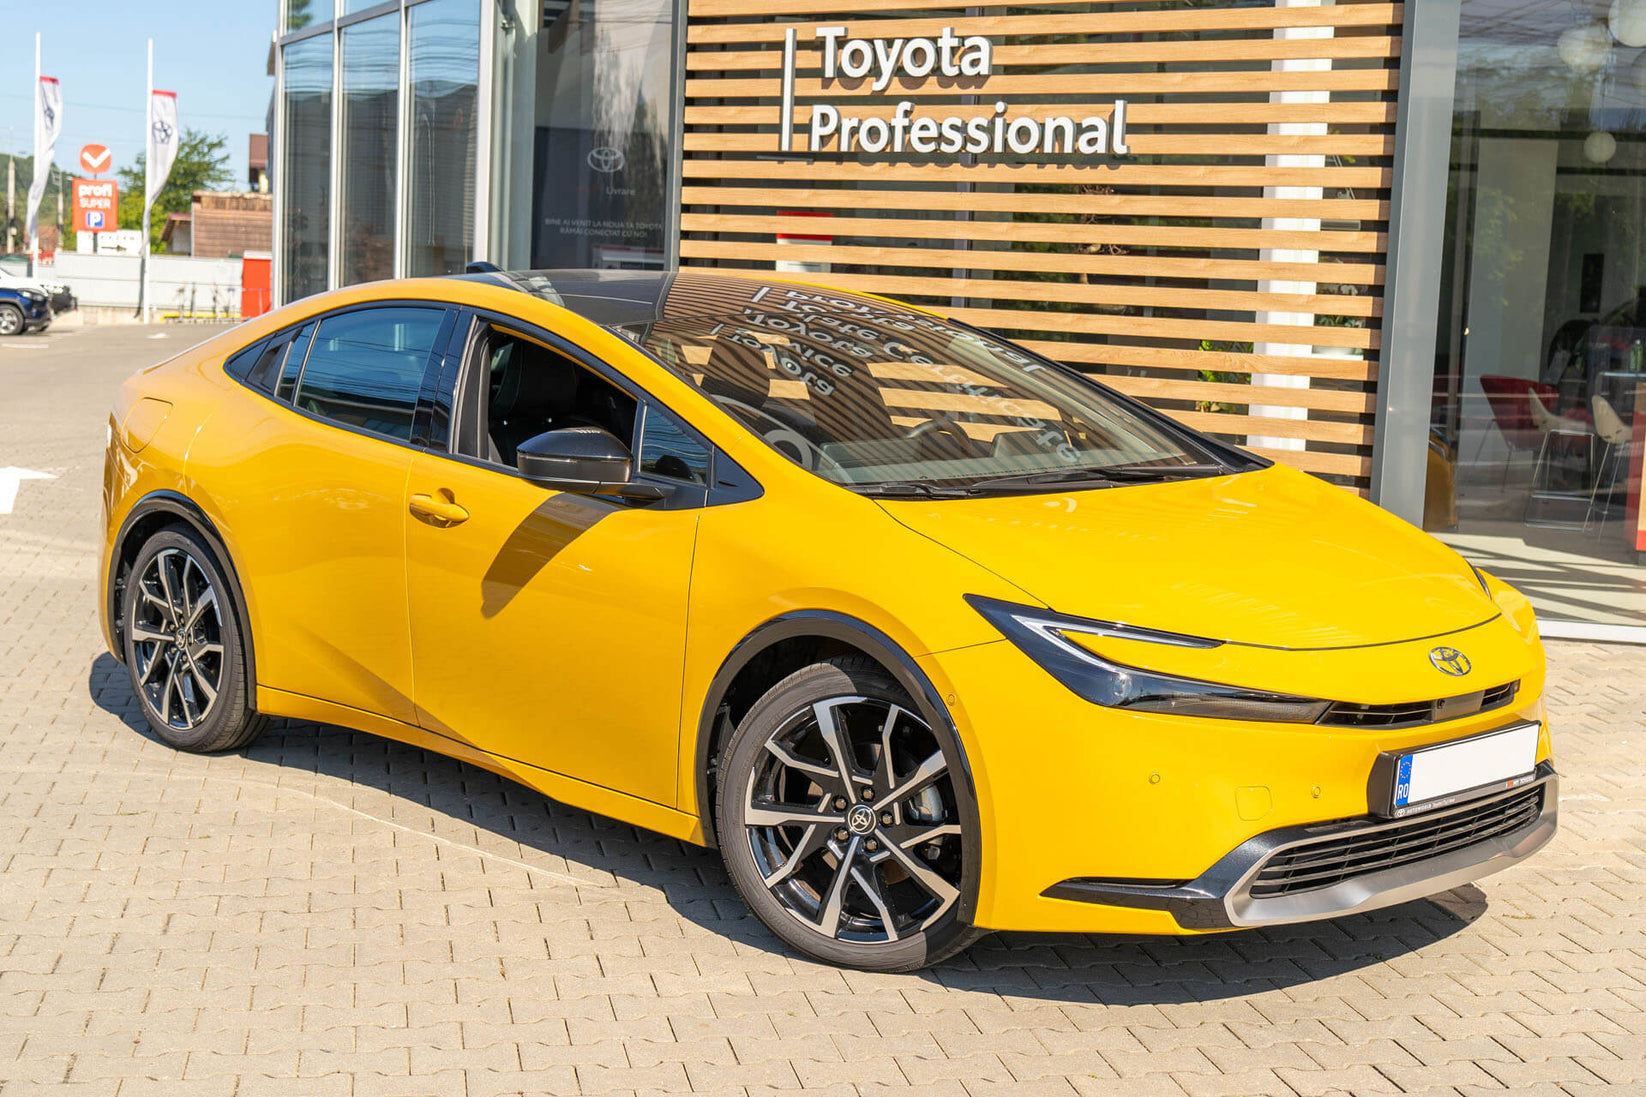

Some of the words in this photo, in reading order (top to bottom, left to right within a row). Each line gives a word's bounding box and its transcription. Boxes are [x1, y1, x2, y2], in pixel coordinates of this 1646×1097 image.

[816, 26, 993, 91] Toyota
[811, 100, 1130, 154] Professional
[78, 183, 112, 198] profi
[79, 198, 111, 209] SUPER
[1397, 782, 1409, 801] RO
